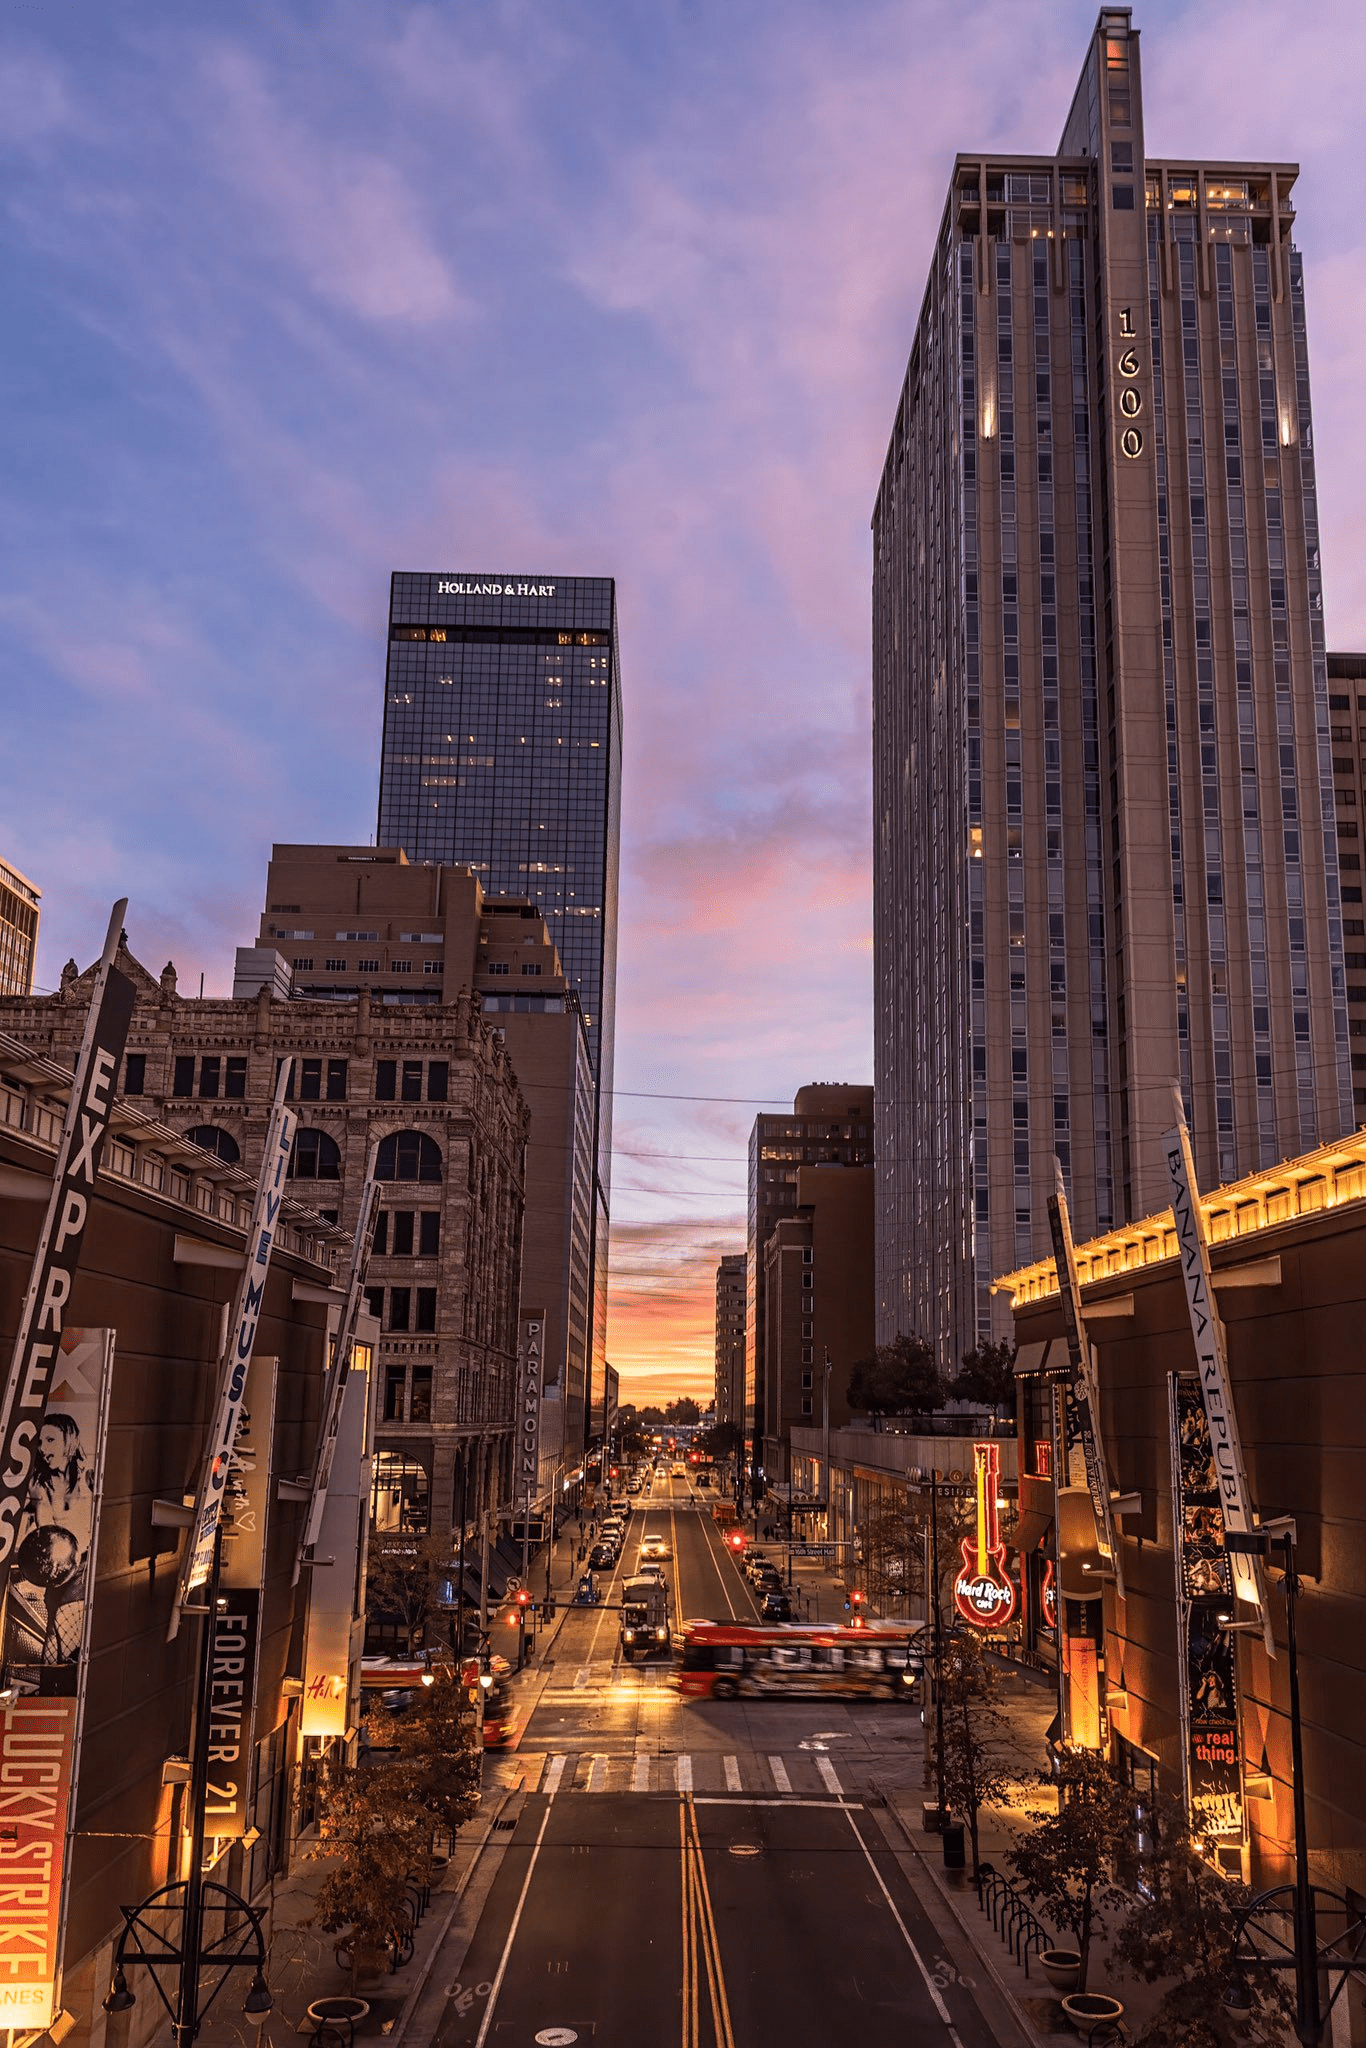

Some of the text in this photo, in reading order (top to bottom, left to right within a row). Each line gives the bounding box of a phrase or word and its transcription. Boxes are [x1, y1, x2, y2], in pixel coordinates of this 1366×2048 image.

[1119, 307, 1143, 458] 1600
[438, 582, 555, 596] HOLLAND & HART
[0, 1046, 116, 1563] EXPRESS
[212, 1115, 289, 1490] LIVE MUSIC
[1168, 1149, 1251, 1580] BANANA REPUBLC
[523, 1323, 540, 1488] PARAMOUNT
[929, 1487, 1004, 1497] ESIDES
[957, 1580, 1010, 1604] Hard Rock
[205, 1615, 248, 1814] FOREVER 21
[1196, 1745, 1239, 1765] thing.
[1207, 1731, 1234, 1745] real
[0, 1709, 69, 1976] LUCKY STRIKE
[0, 1989, 44, 2005] NES
